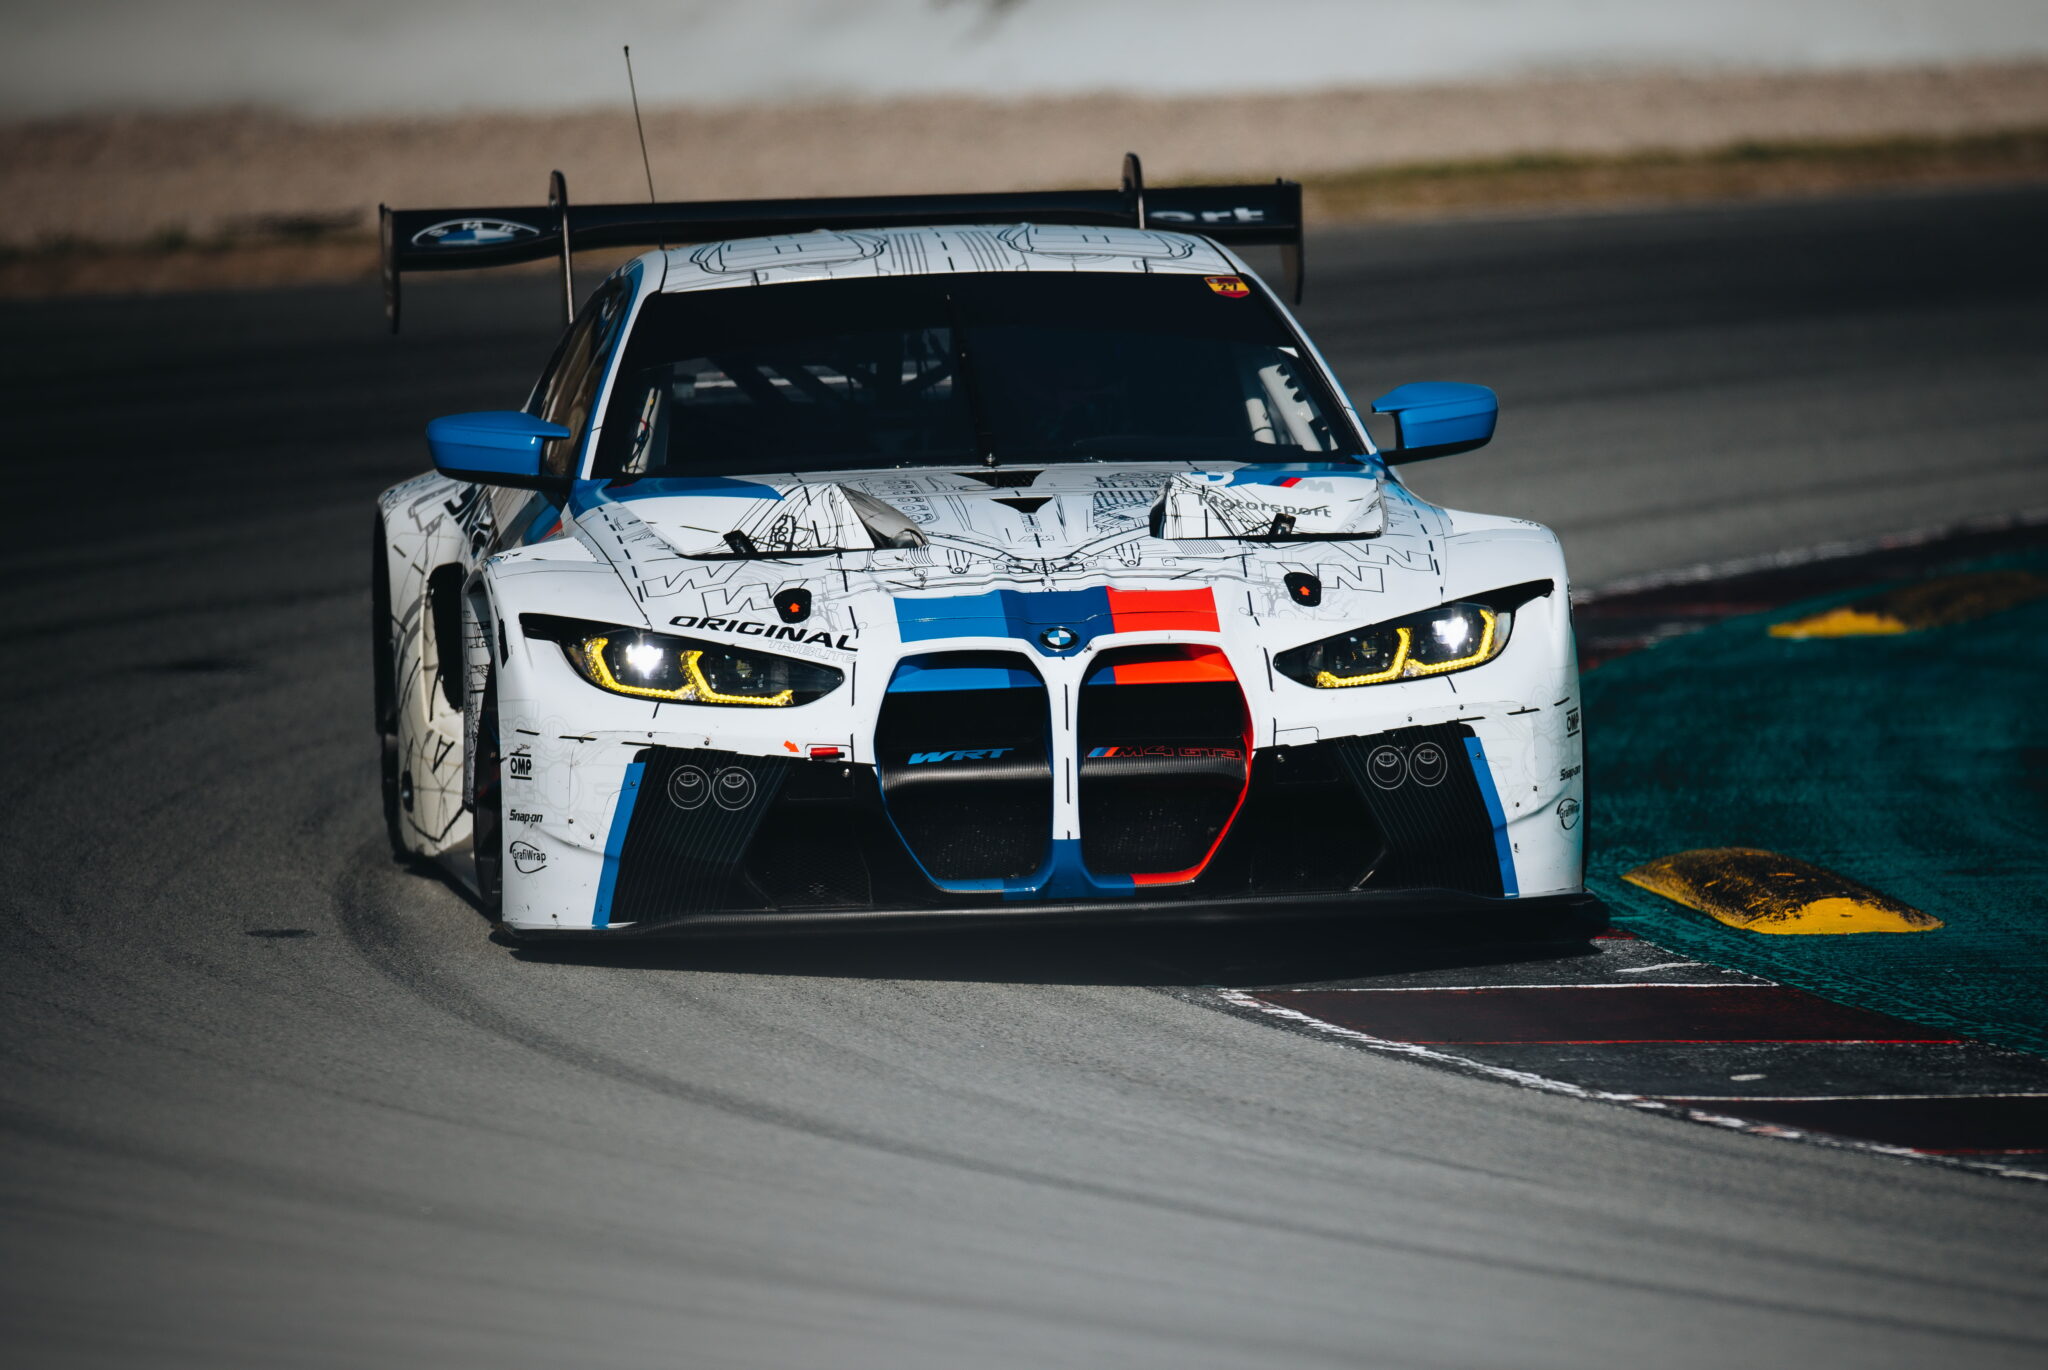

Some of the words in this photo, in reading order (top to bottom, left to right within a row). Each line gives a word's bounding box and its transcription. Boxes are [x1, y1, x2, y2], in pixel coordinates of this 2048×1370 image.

[1199, 494, 1332, 519] Motorsport
[669, 616, 858, 652] ORIGINAL
[767, 638, 857, 664] TRIBUTE
[907, 748, 1015, 765] WRT
[1179, 748, 1243, 761] GT3
[510, 757, 532, 776] OMP
[509, 809, 543, 824] Snap-on
[511, 848, 547, 863] GrafiWrap
